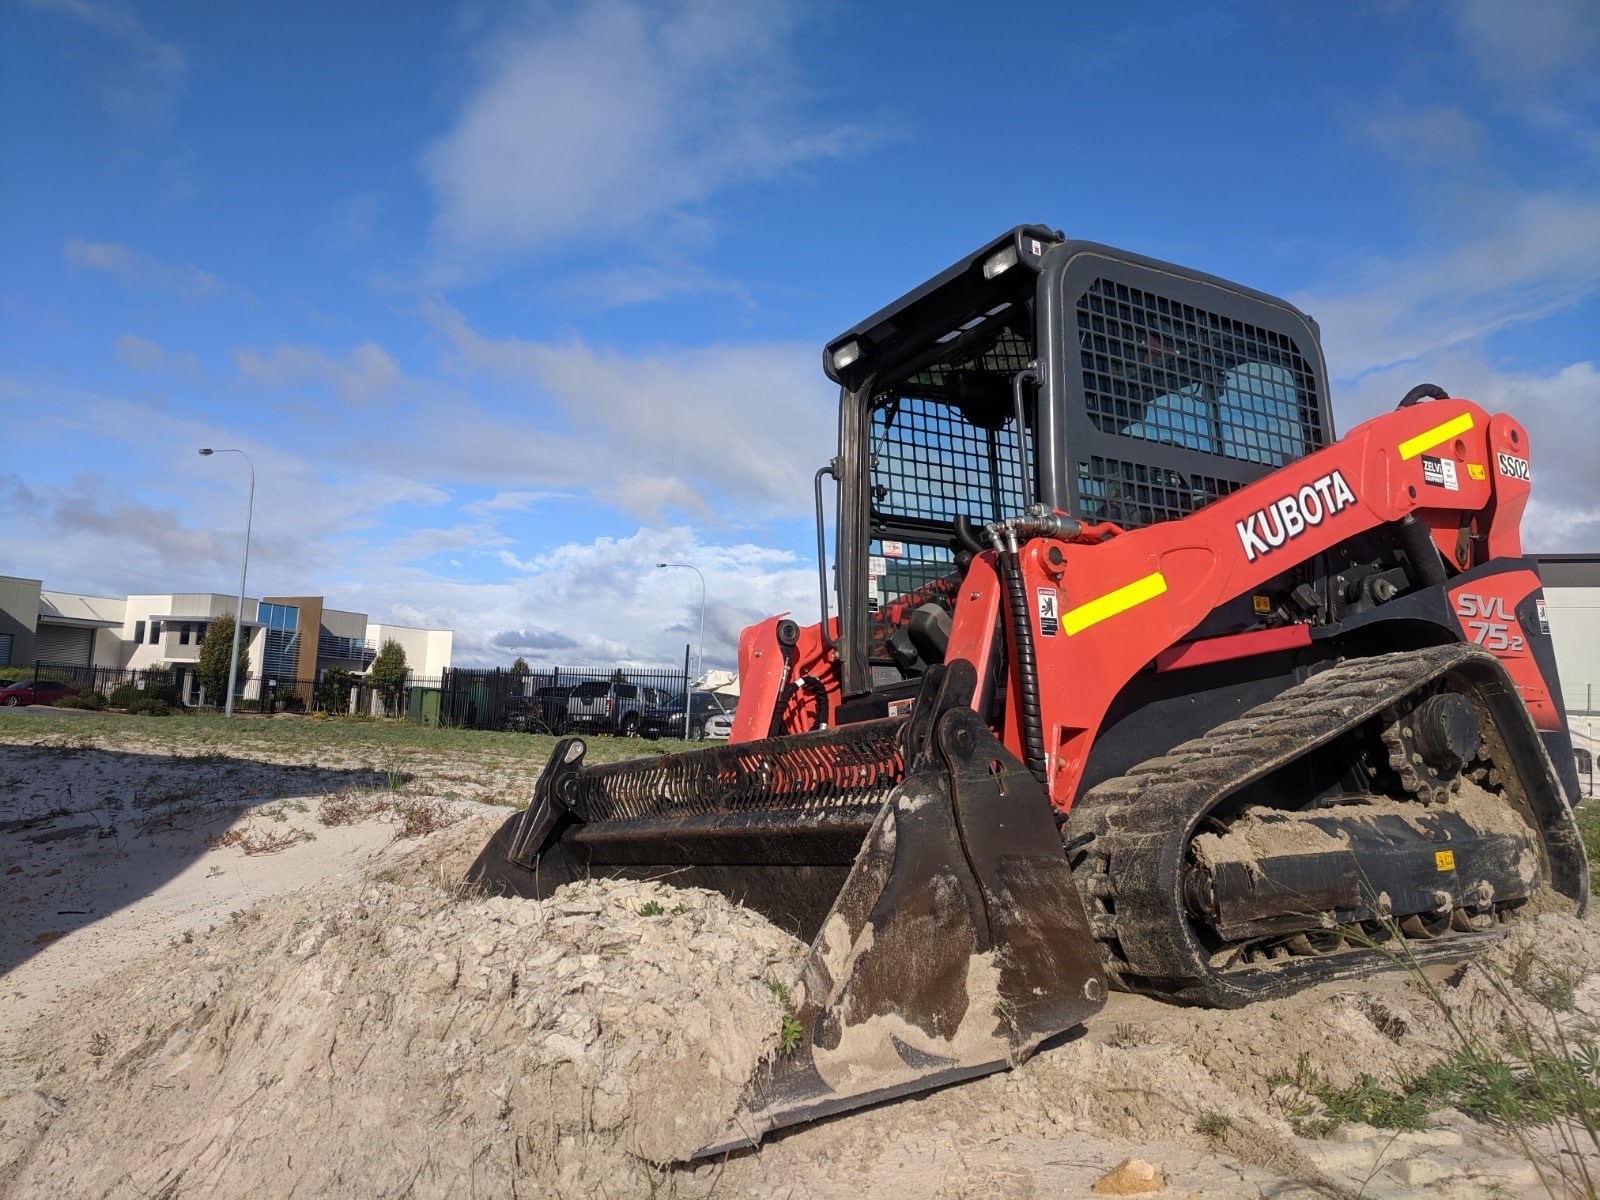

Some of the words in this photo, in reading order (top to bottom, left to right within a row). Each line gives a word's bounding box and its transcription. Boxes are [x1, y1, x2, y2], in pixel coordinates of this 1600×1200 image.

[1499, 454, 1530, 480] SS02
[1236, 469, 1357, 562] KUBOTA
[1457, 593, 1515, 620] SVL
